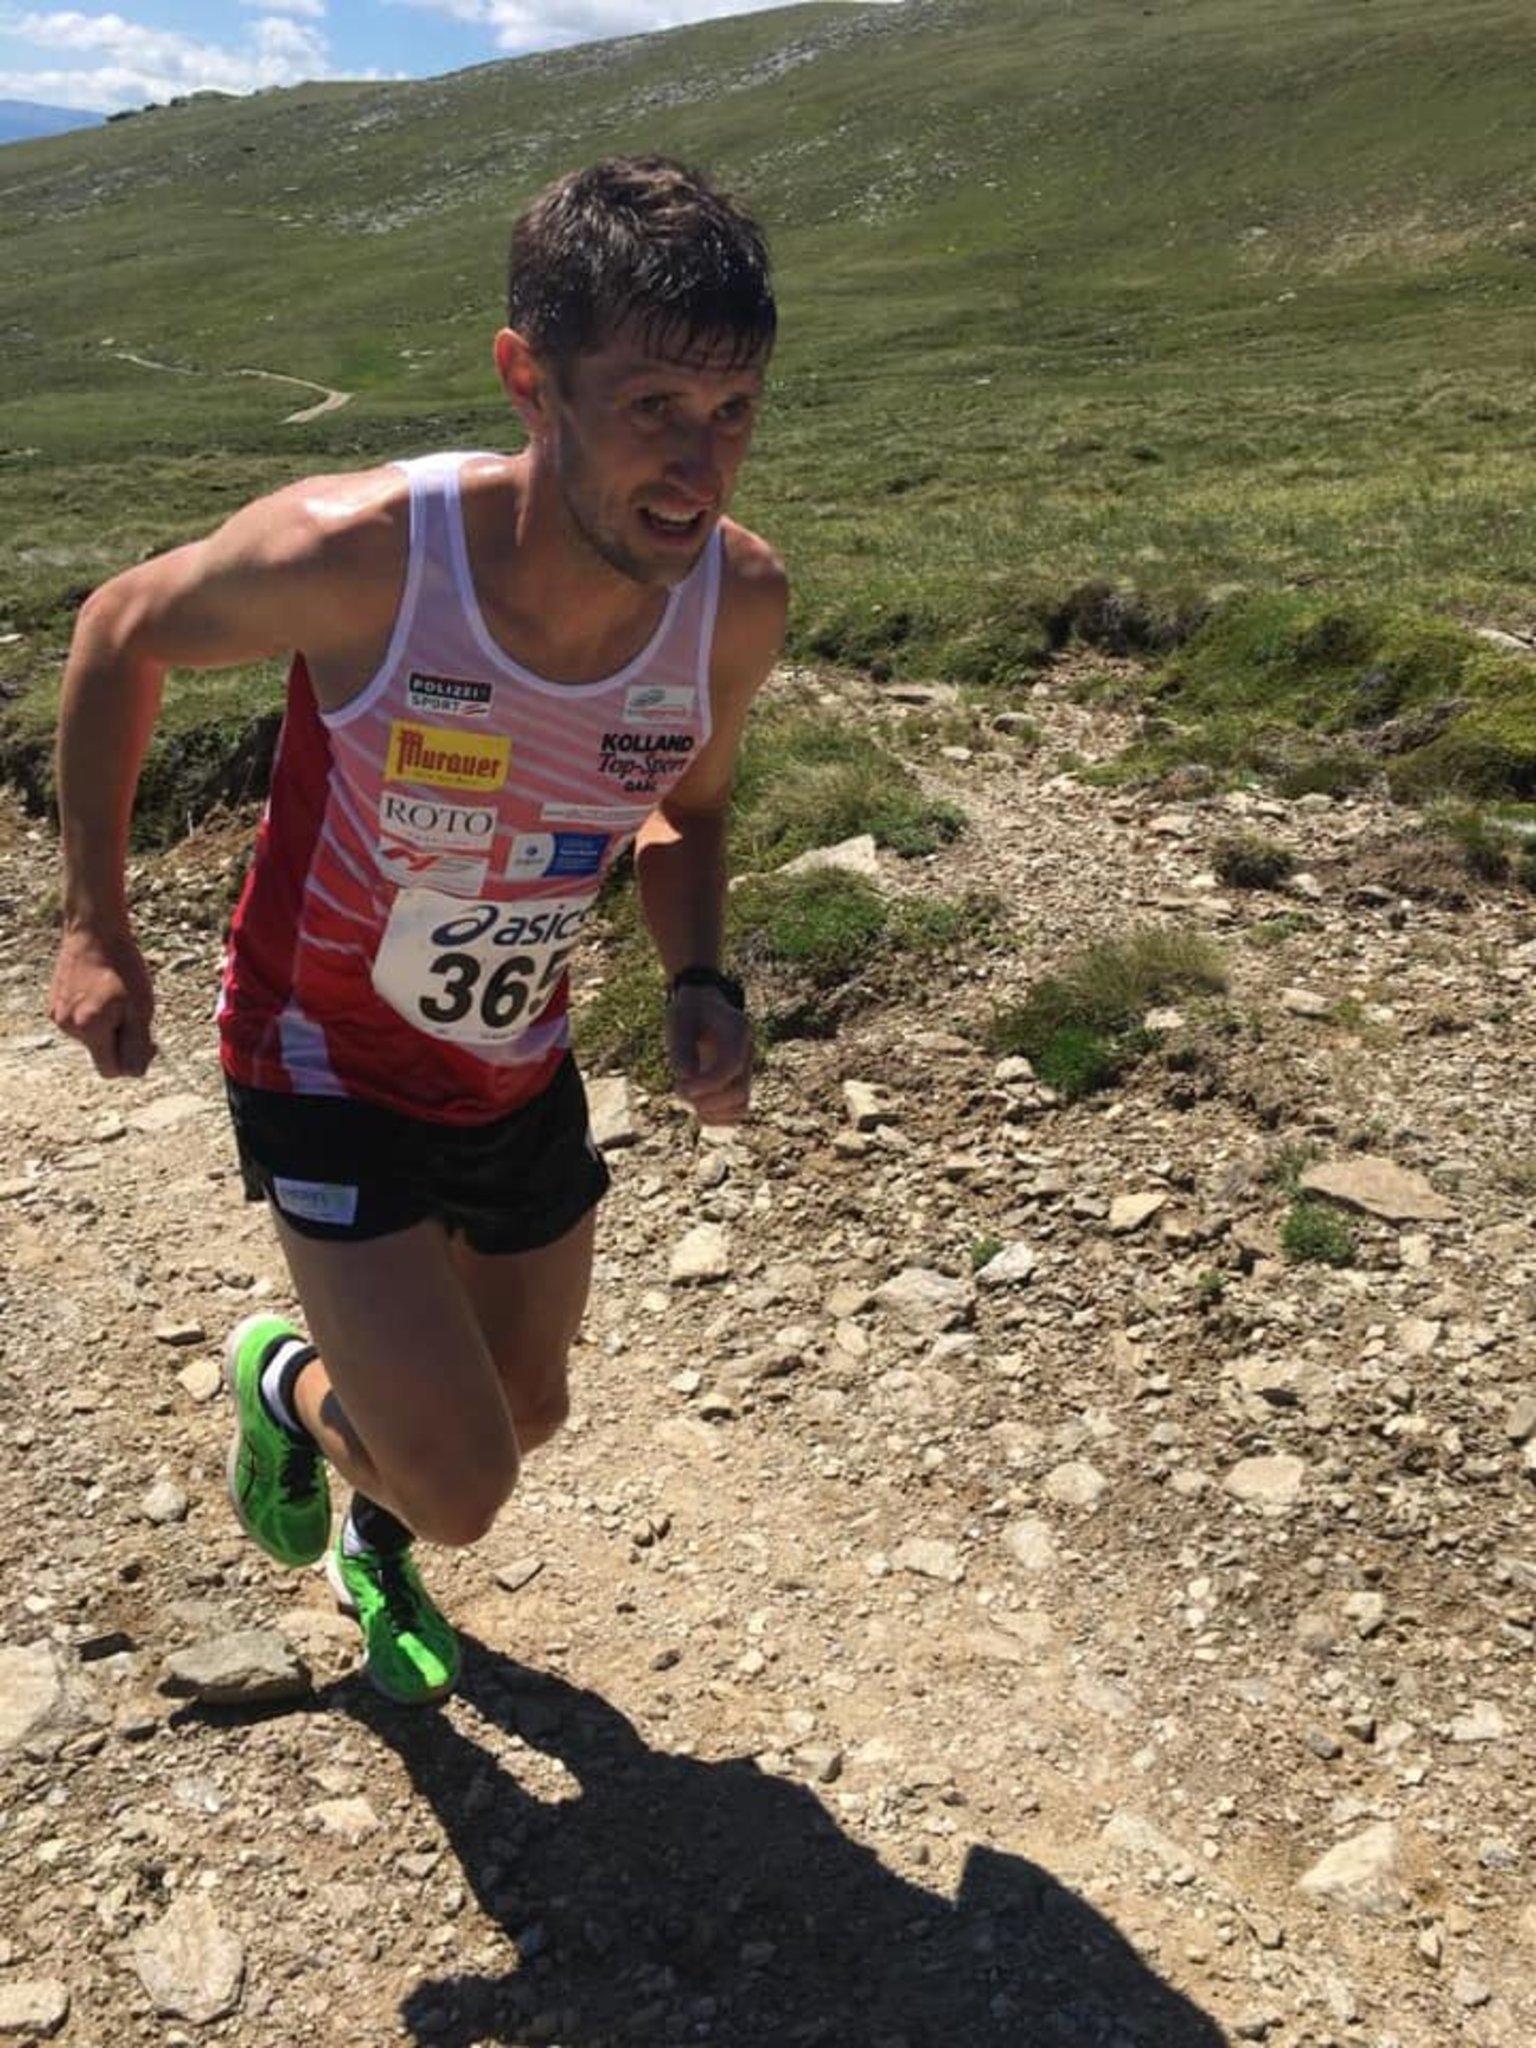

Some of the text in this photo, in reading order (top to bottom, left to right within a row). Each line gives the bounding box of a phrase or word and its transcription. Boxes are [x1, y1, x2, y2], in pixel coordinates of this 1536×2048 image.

[411, 694, 460, 712] SPORT
[412, 678, 480, 699] POLIZEI
[397, 729, 502, 779] Murauer
[601, 732, 695, 753] KOLLAND
[386, 796, 493, 837] ROTO
[493, 904, 589, 946] asic
